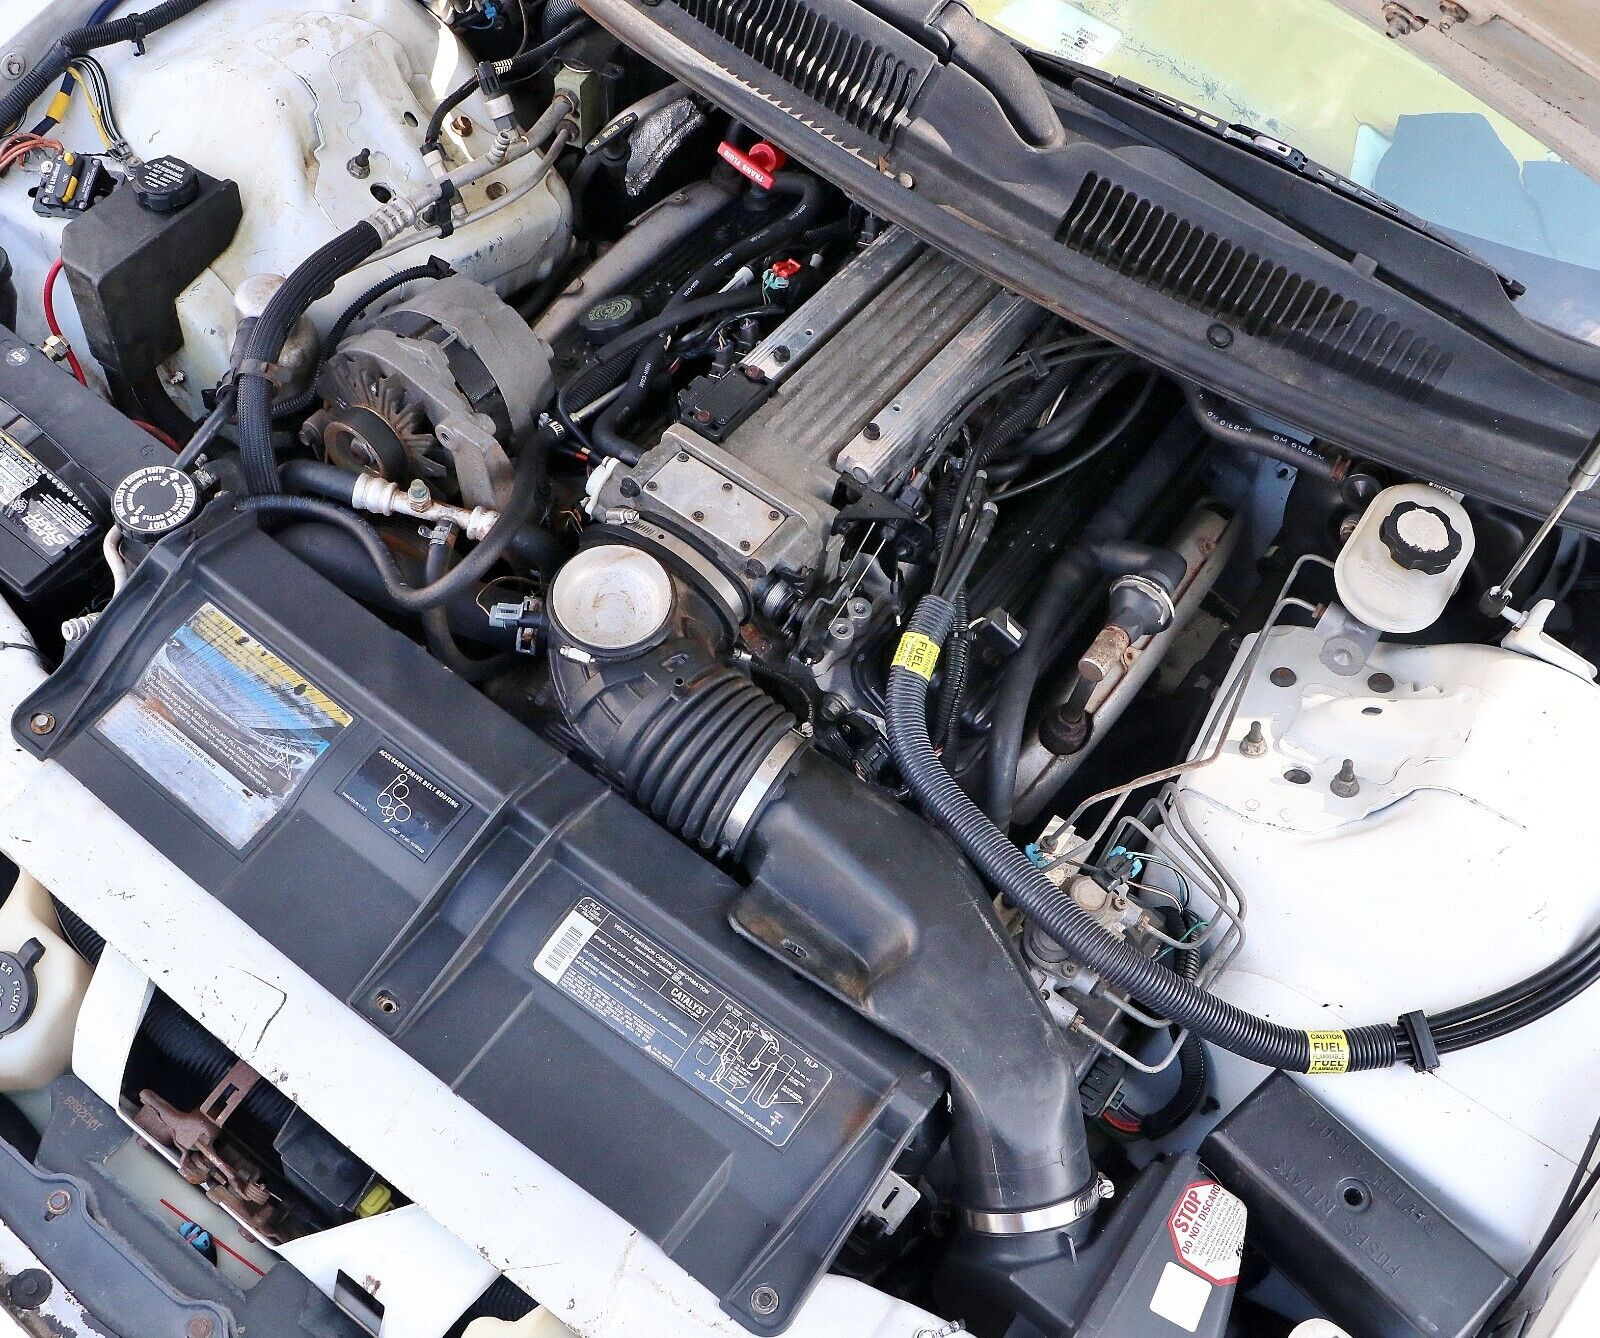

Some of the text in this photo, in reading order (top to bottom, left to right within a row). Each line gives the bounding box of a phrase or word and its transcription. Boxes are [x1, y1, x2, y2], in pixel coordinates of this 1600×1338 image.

[589, 137, 601, 148] OIL
[152, 162, 183, 180] STEERING
[161, 158, 185, 173] POWER
[721, 149, 765, 183] TRANS FLUID
[182, 482, 194, 506] NEVER
[21, 514, 55, 547] SUPER
[31, 511, 69, 546] START
[147, 519, 166, 528] HOT
[909, 640, 929, 669] FUEL
[378, 748, 459, 809] ACCESSORY DRIVE BELT ROUTING
[589, 902, 601, 912] RLP
[592, 934, 607, 946] SPARK
[605, 943, 617, 954] PLUG
[615, 951, 626, 960] GAP
[612, 922, 711, 995] VEHICLE EMISSION CONTROL INFORMATION
[0, 960, 20, 1012] ER FLUID
[669, 986, 709, 1018] CATALYST
[1313, 1042, 1343, 1052] FUEL
[802, 1056, 819, 1070] RLP
[1171, 1188, 1205, 1234] STOP
[1180, 1183, 1222, 1254] DO NOT DISCARD
